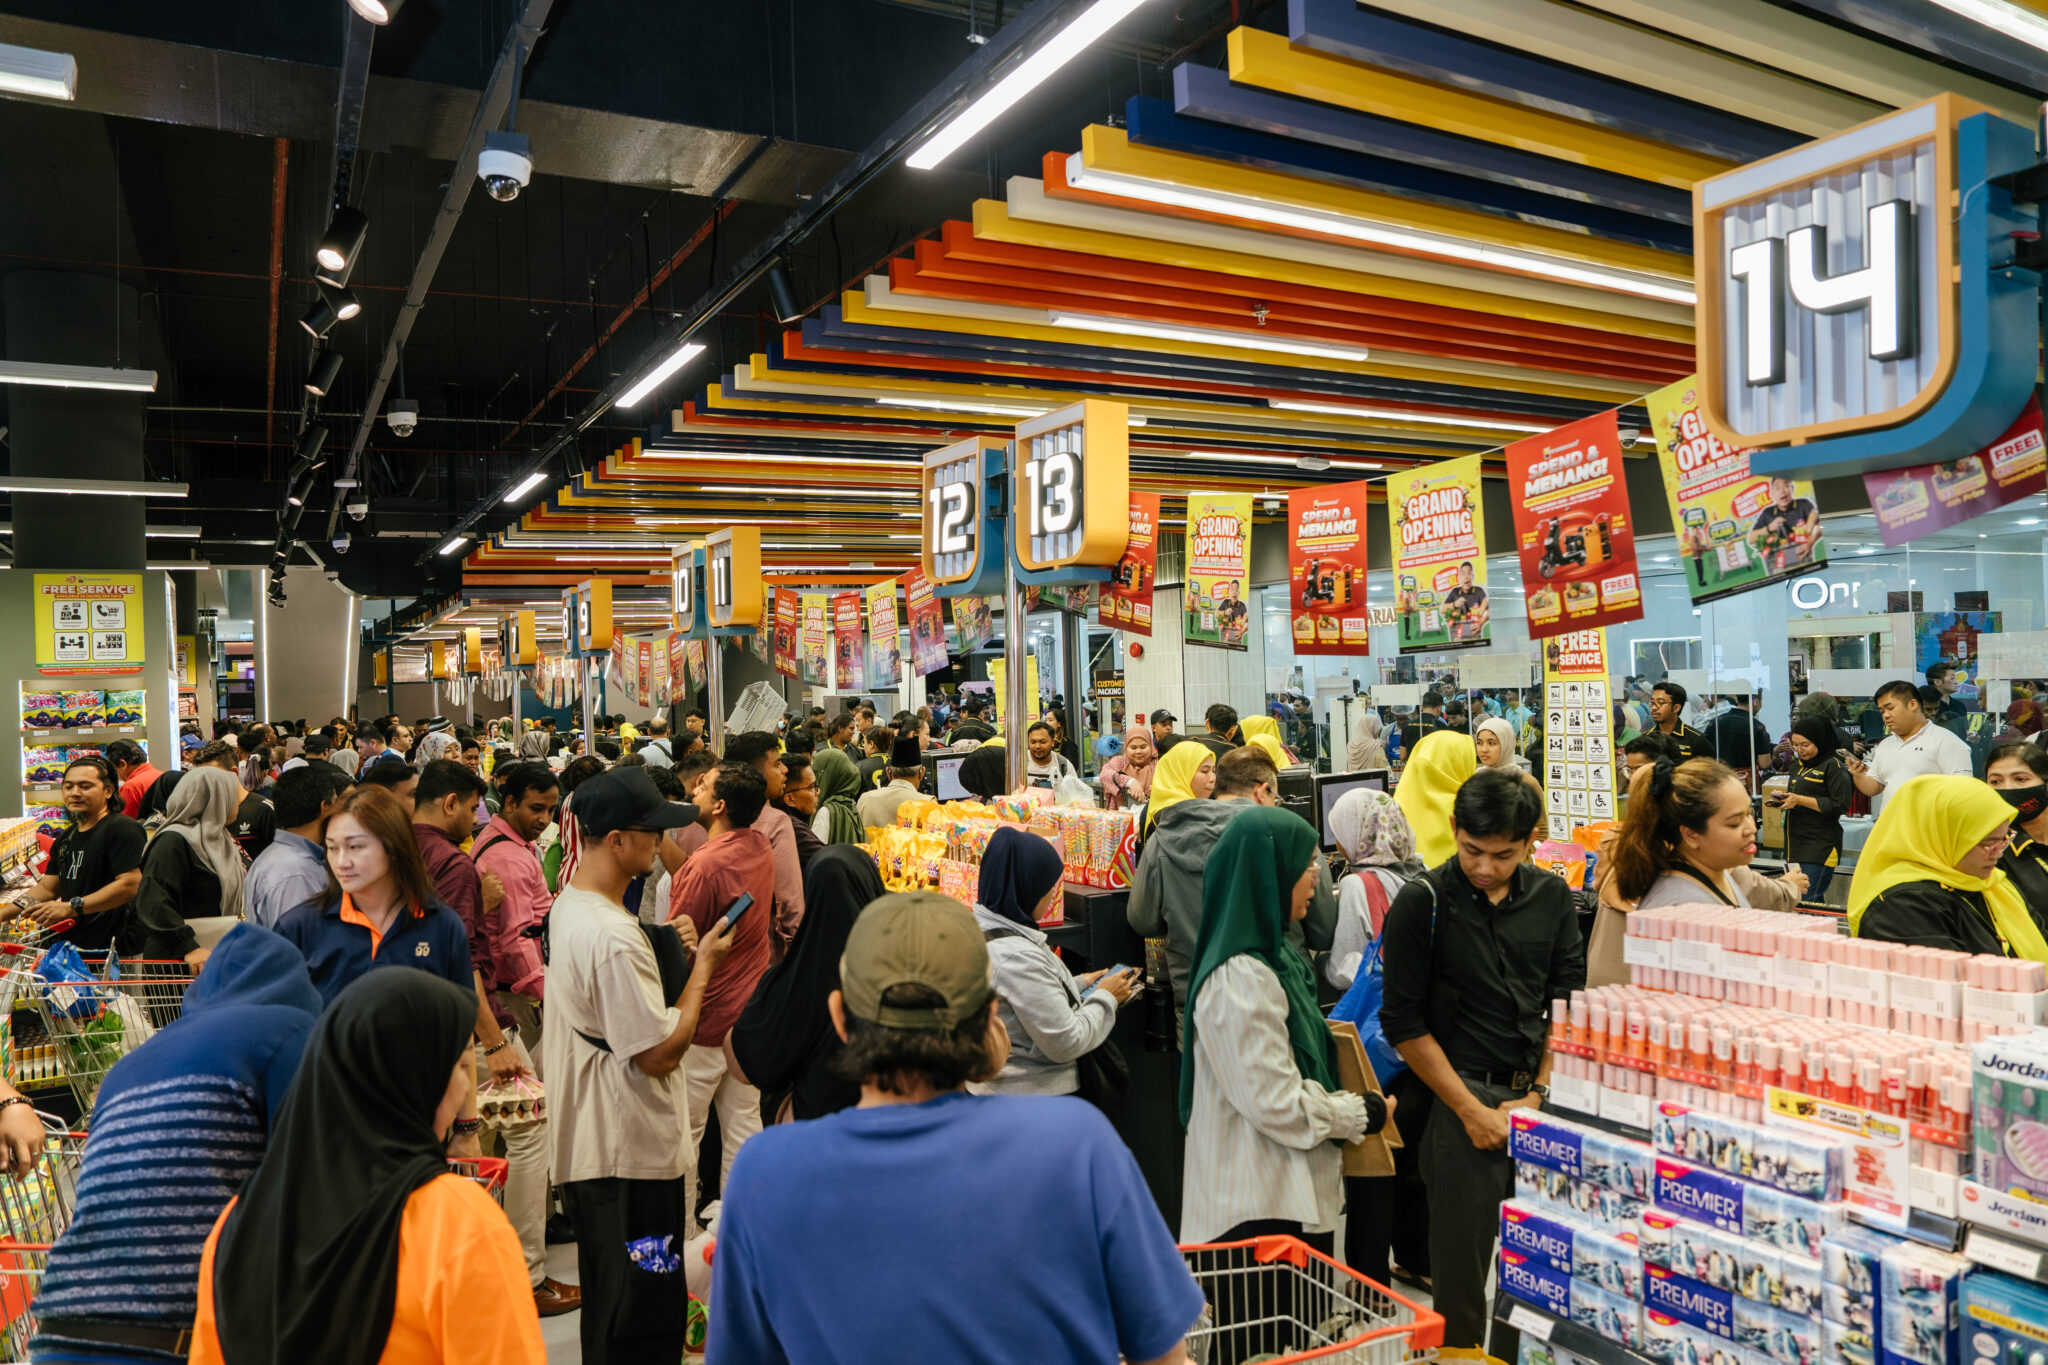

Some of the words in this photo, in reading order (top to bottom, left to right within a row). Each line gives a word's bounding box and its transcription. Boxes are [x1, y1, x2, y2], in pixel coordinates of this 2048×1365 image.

[1731, 201, 1900, 383] 14
[1528, 450, 1582, 480] SPEND
[1587, 445, 1599, 462] &
[1994, 433, 2039, 461] FREE!
[1524, 457, 1609, 498] MENANG!
[1026, 452, 1076, 536] 13
[1408, 488, 1463, 519] GRAND
[929, 481, 968, 554] 12
[1200, 517, 1238, 536] GRAND
[1298, 519, 1357, 538] MENANG!
[1302, 508, 1340, 524] SPEND
[1342, 506, 1351, 519] &
[1402, 511, 1472, 544] OPENING
[1194, 537, 1242, 557] OPENING
[42, 585, 76, 594] FREE
[79, 585, 135, 594] SERVICE
[672, 567, 689, 614] 10
[712, 557, 729, 606] 11
[1604, 576, 1632, 591] FREE!
[580, 601, 589, 636] 9
[873, 595, 893, 614] GRAND
[873, 608, 894, 626] OPENING
[1136, 604, 1149, 614] FREE!
[562, 607, 569, 640] 8
[1344, 620, 1363, 628] FREE!
[1559, 630, 1600, 653] FREE
[1559, 652, 1602, 666] SERVICE
[415, 946, 430, 957] 99
[1514, 1130, 1577, 1164] PREMIER
[1660, 1178, 1737, 1219] PREMIER
[1988, 1201, 2047, 1227] Jordan
[1506, 1221, 1568, 1260] PREMIER
[1504, 1263, 1567, 1303] PREMIER
[1650, 1281, 1726, 1323] PREMIER
